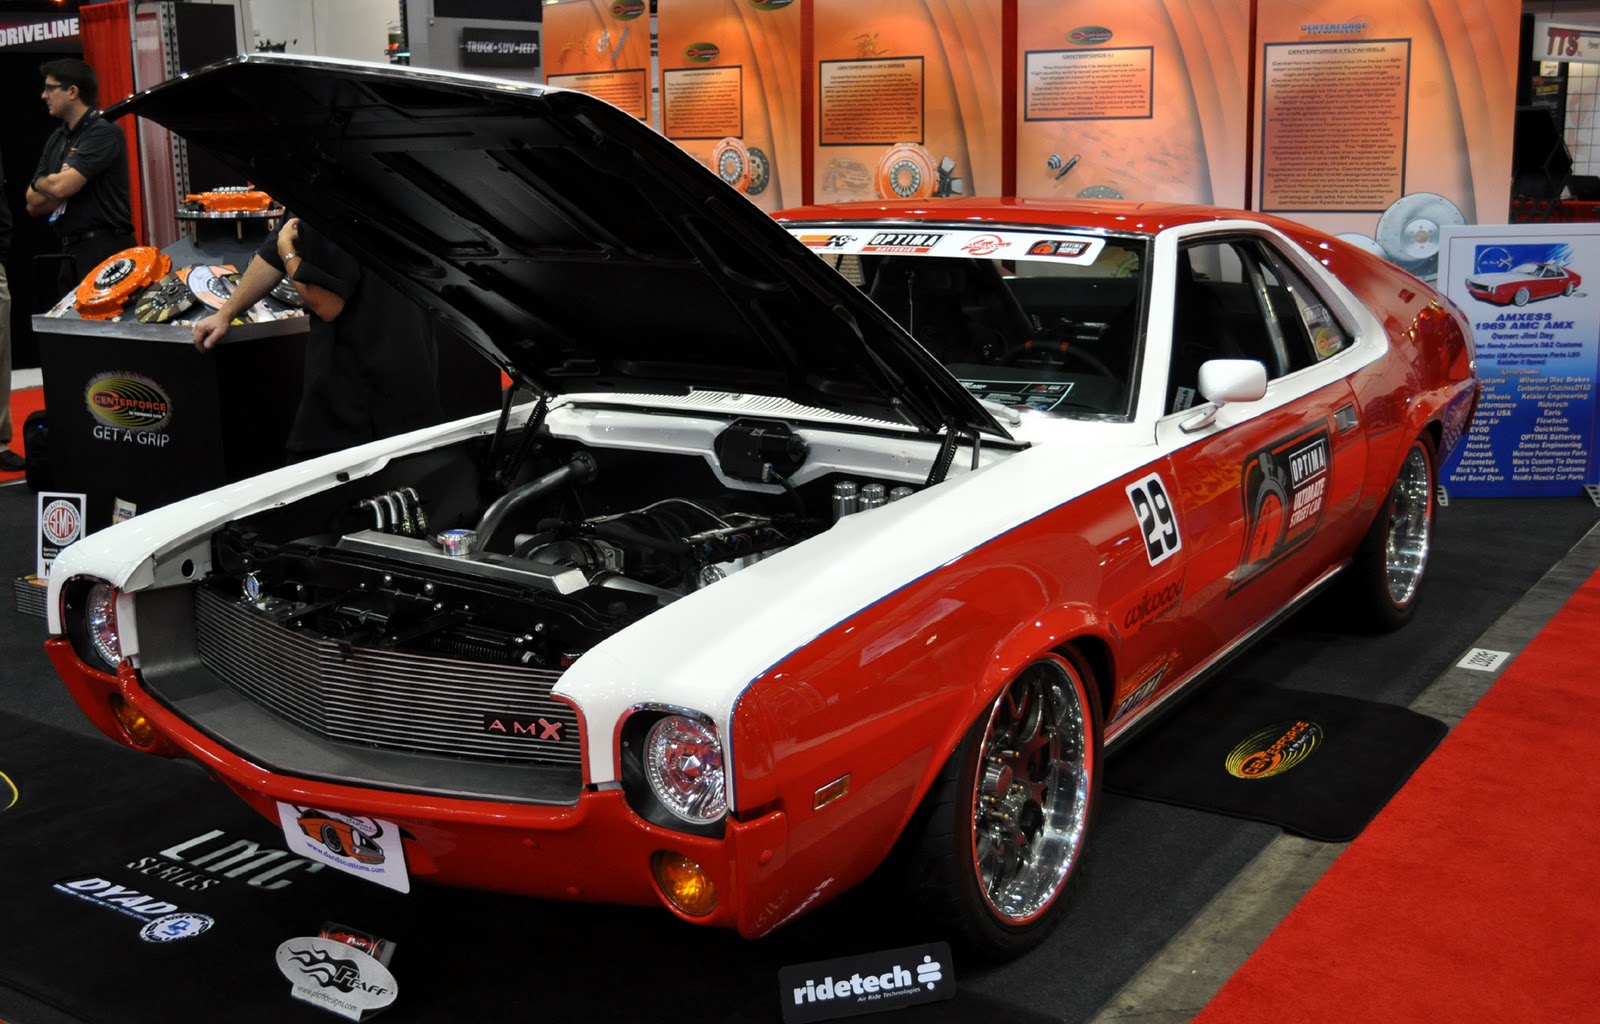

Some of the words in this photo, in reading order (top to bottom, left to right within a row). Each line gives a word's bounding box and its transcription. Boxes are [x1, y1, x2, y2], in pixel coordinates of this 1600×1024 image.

[0, 18, 79, 47] DRIVELINE
[1546, 26, 1581, 56] TTS
[870, 234, 939, 246] OPTIMA
[1496, 313, 1552, 321] AMXESS
[94, 395, 166, 412] CENTERFORCE
[93, 425, 120, 442] GET
[123, 430, 133, 442] A
[137, 432, 170, 447] GRIP
[1292, 446, 1324, 482] OPTIMA
[1294, 477, 1326, 511] ULTIMATE
[49, 508, 73, 538] SEMA
[1131, 478, 1178, 560] 29
[489, 718, 562, 741] AMX
[1244, 721, 1309, 773] CENTERFORCE
[126, 857, 220, 891] SERIES
[66, 878, 178, 914] DYAD
[794, 965, 912, 1004] ridetech
[883, 987, 921, 998] Technologies
